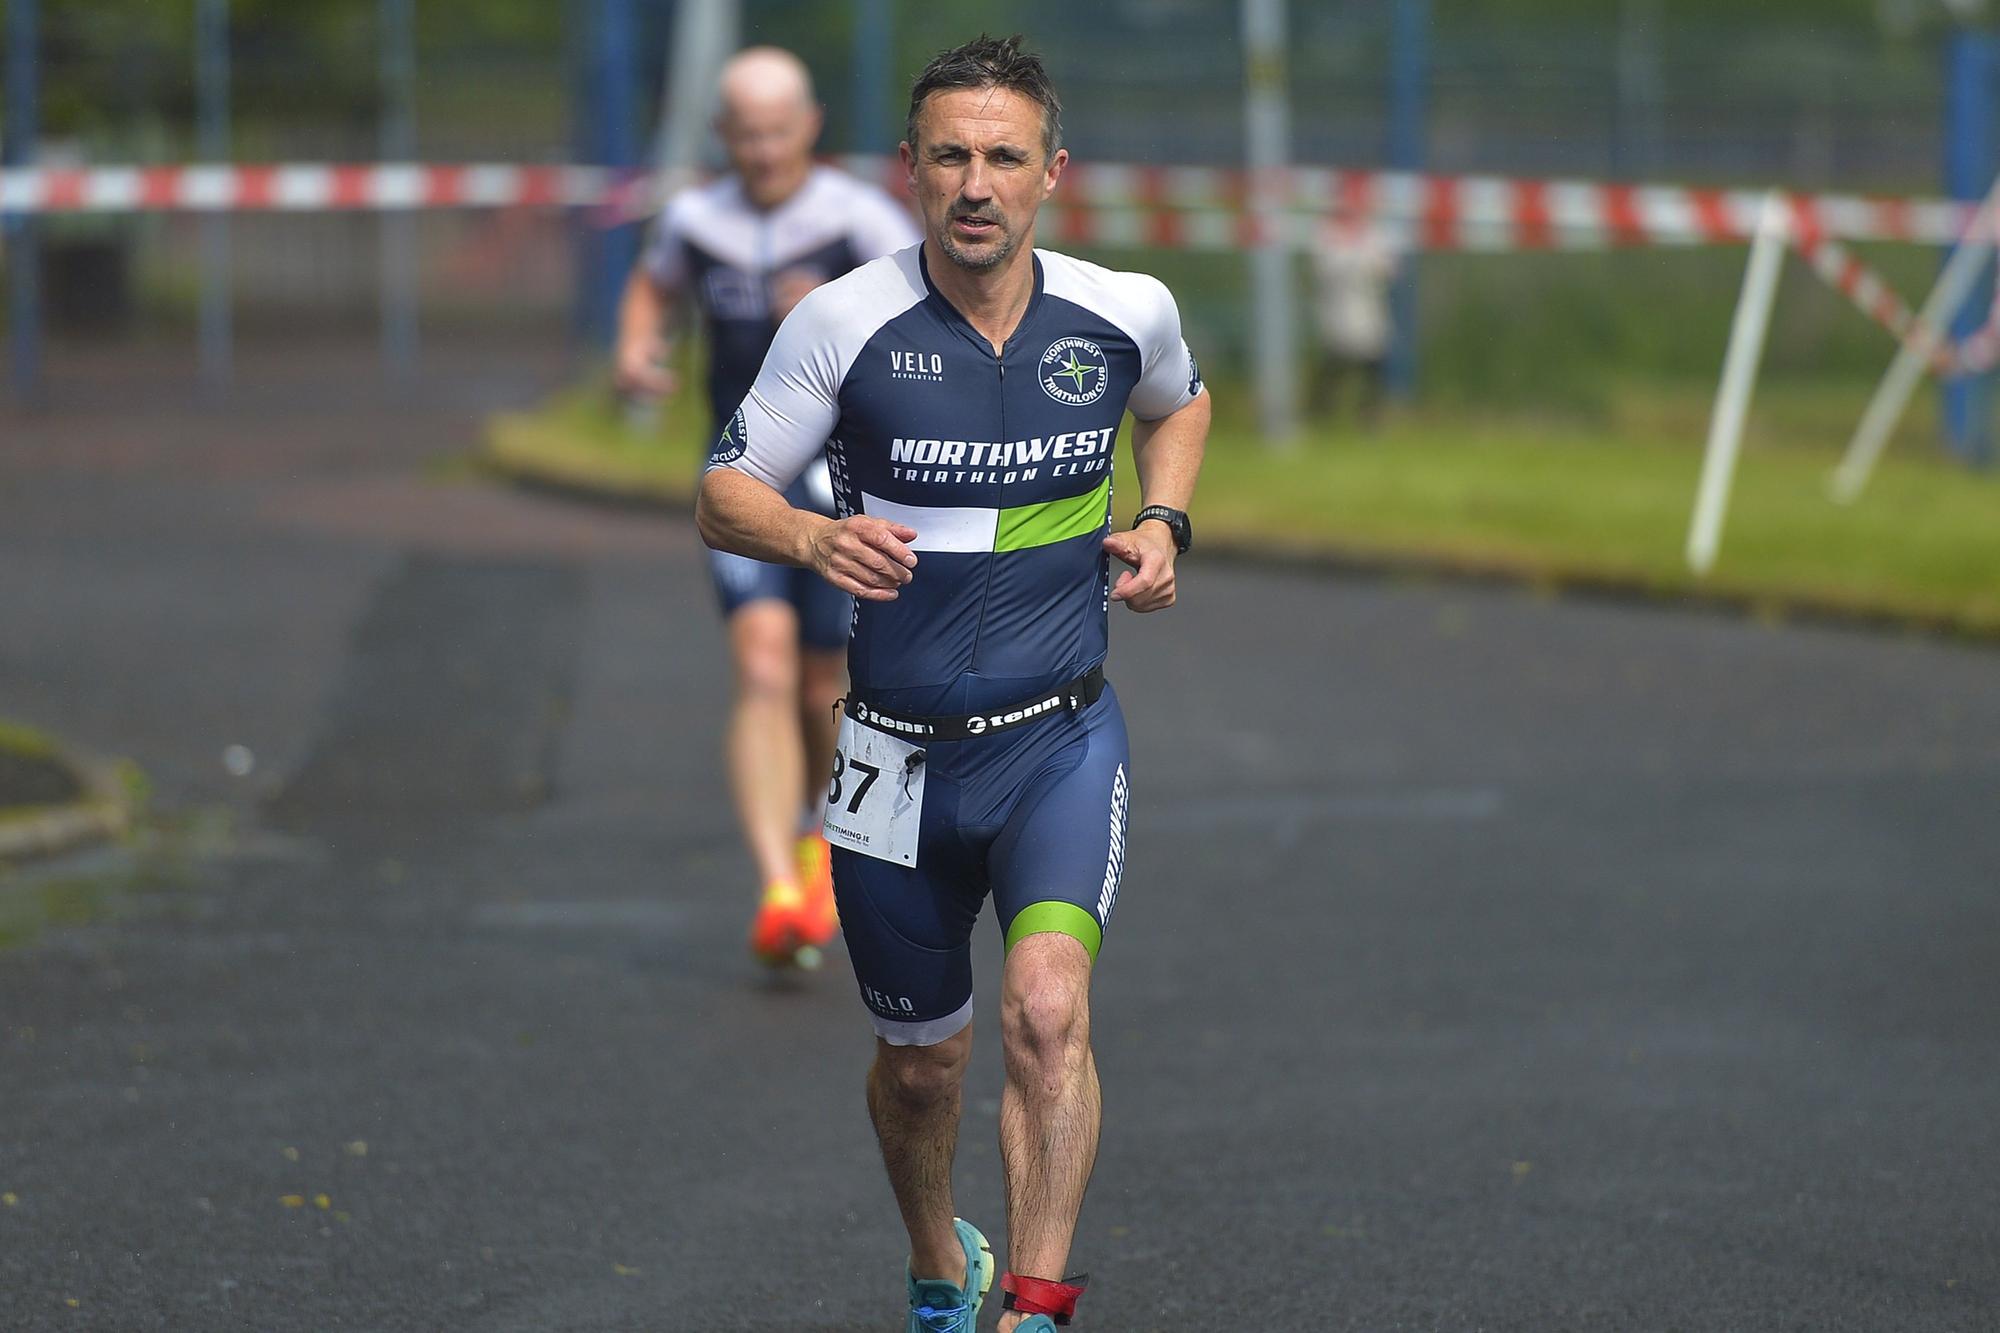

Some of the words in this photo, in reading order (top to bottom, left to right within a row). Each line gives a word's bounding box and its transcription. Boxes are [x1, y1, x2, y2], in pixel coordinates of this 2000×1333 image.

[890, 350, 942, 374] VELO
[1043, 339, 1100, 364] NORTHWEST
[1043, 376, 1098, 403] TRIATHLON
[1095, 366, 1106, 392] CLUB
[890, 427, 1114, 467] NORTHWEST
[892, 467, 1039, 484] TRIATHLON
[1052, 457, 1106, 477] CLUB
[990, 696, 1060, 727] tenn
[828, 748, 880, 814] 87
[1096, 762, 1127, 926] NORTHWEST
[864, 983, 913, 1011] VELO
